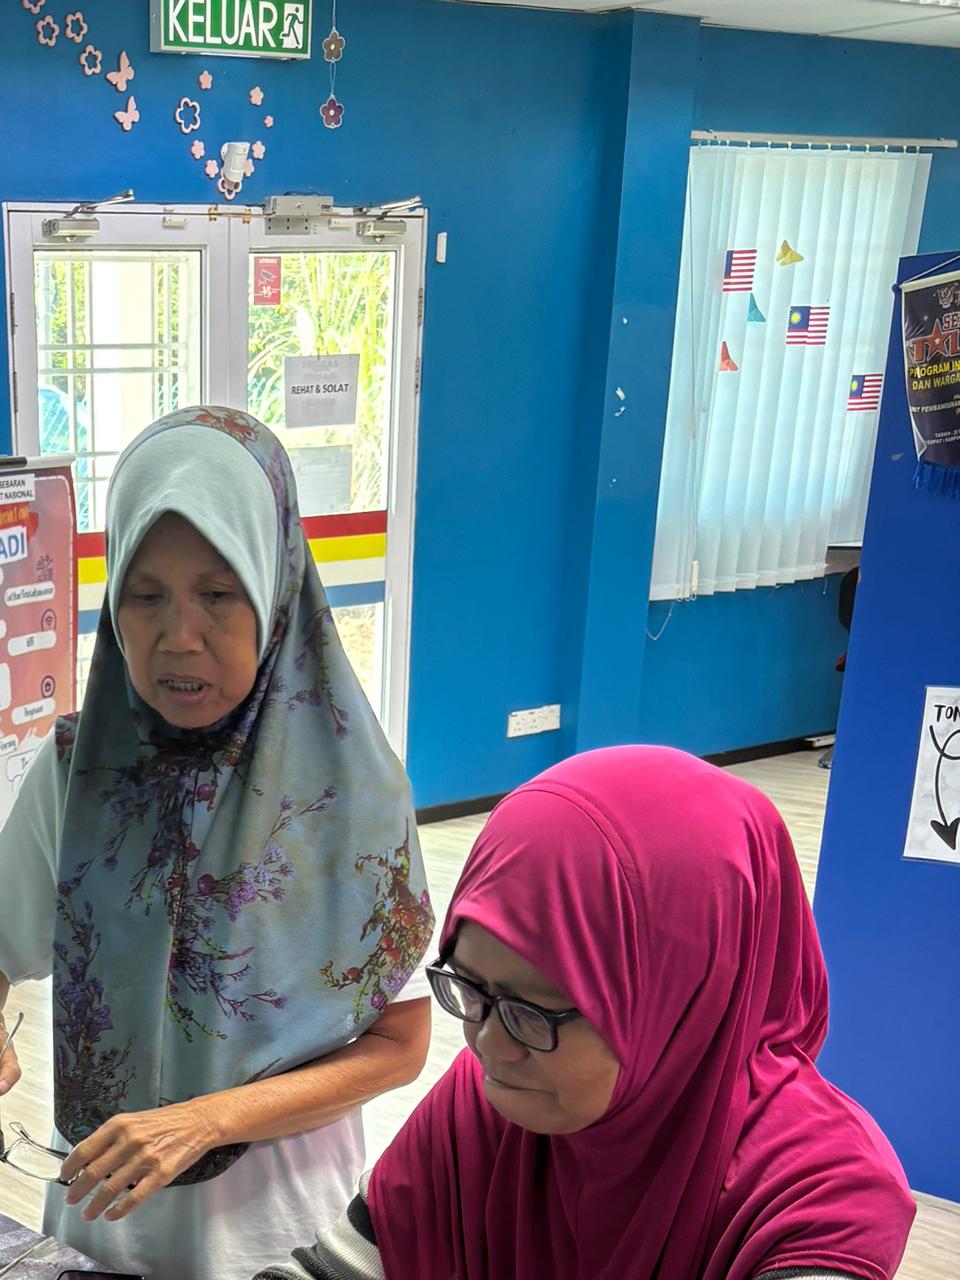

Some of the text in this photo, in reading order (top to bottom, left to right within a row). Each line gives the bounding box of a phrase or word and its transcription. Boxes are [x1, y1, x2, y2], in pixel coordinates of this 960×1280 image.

[168, 0, 278, 48] KELUAR
[291, 383, 350, 396] REHAT & SOLAT
[912, 377, 932, 391] DAN
[4, 490, 34, 499] NASIONAL
